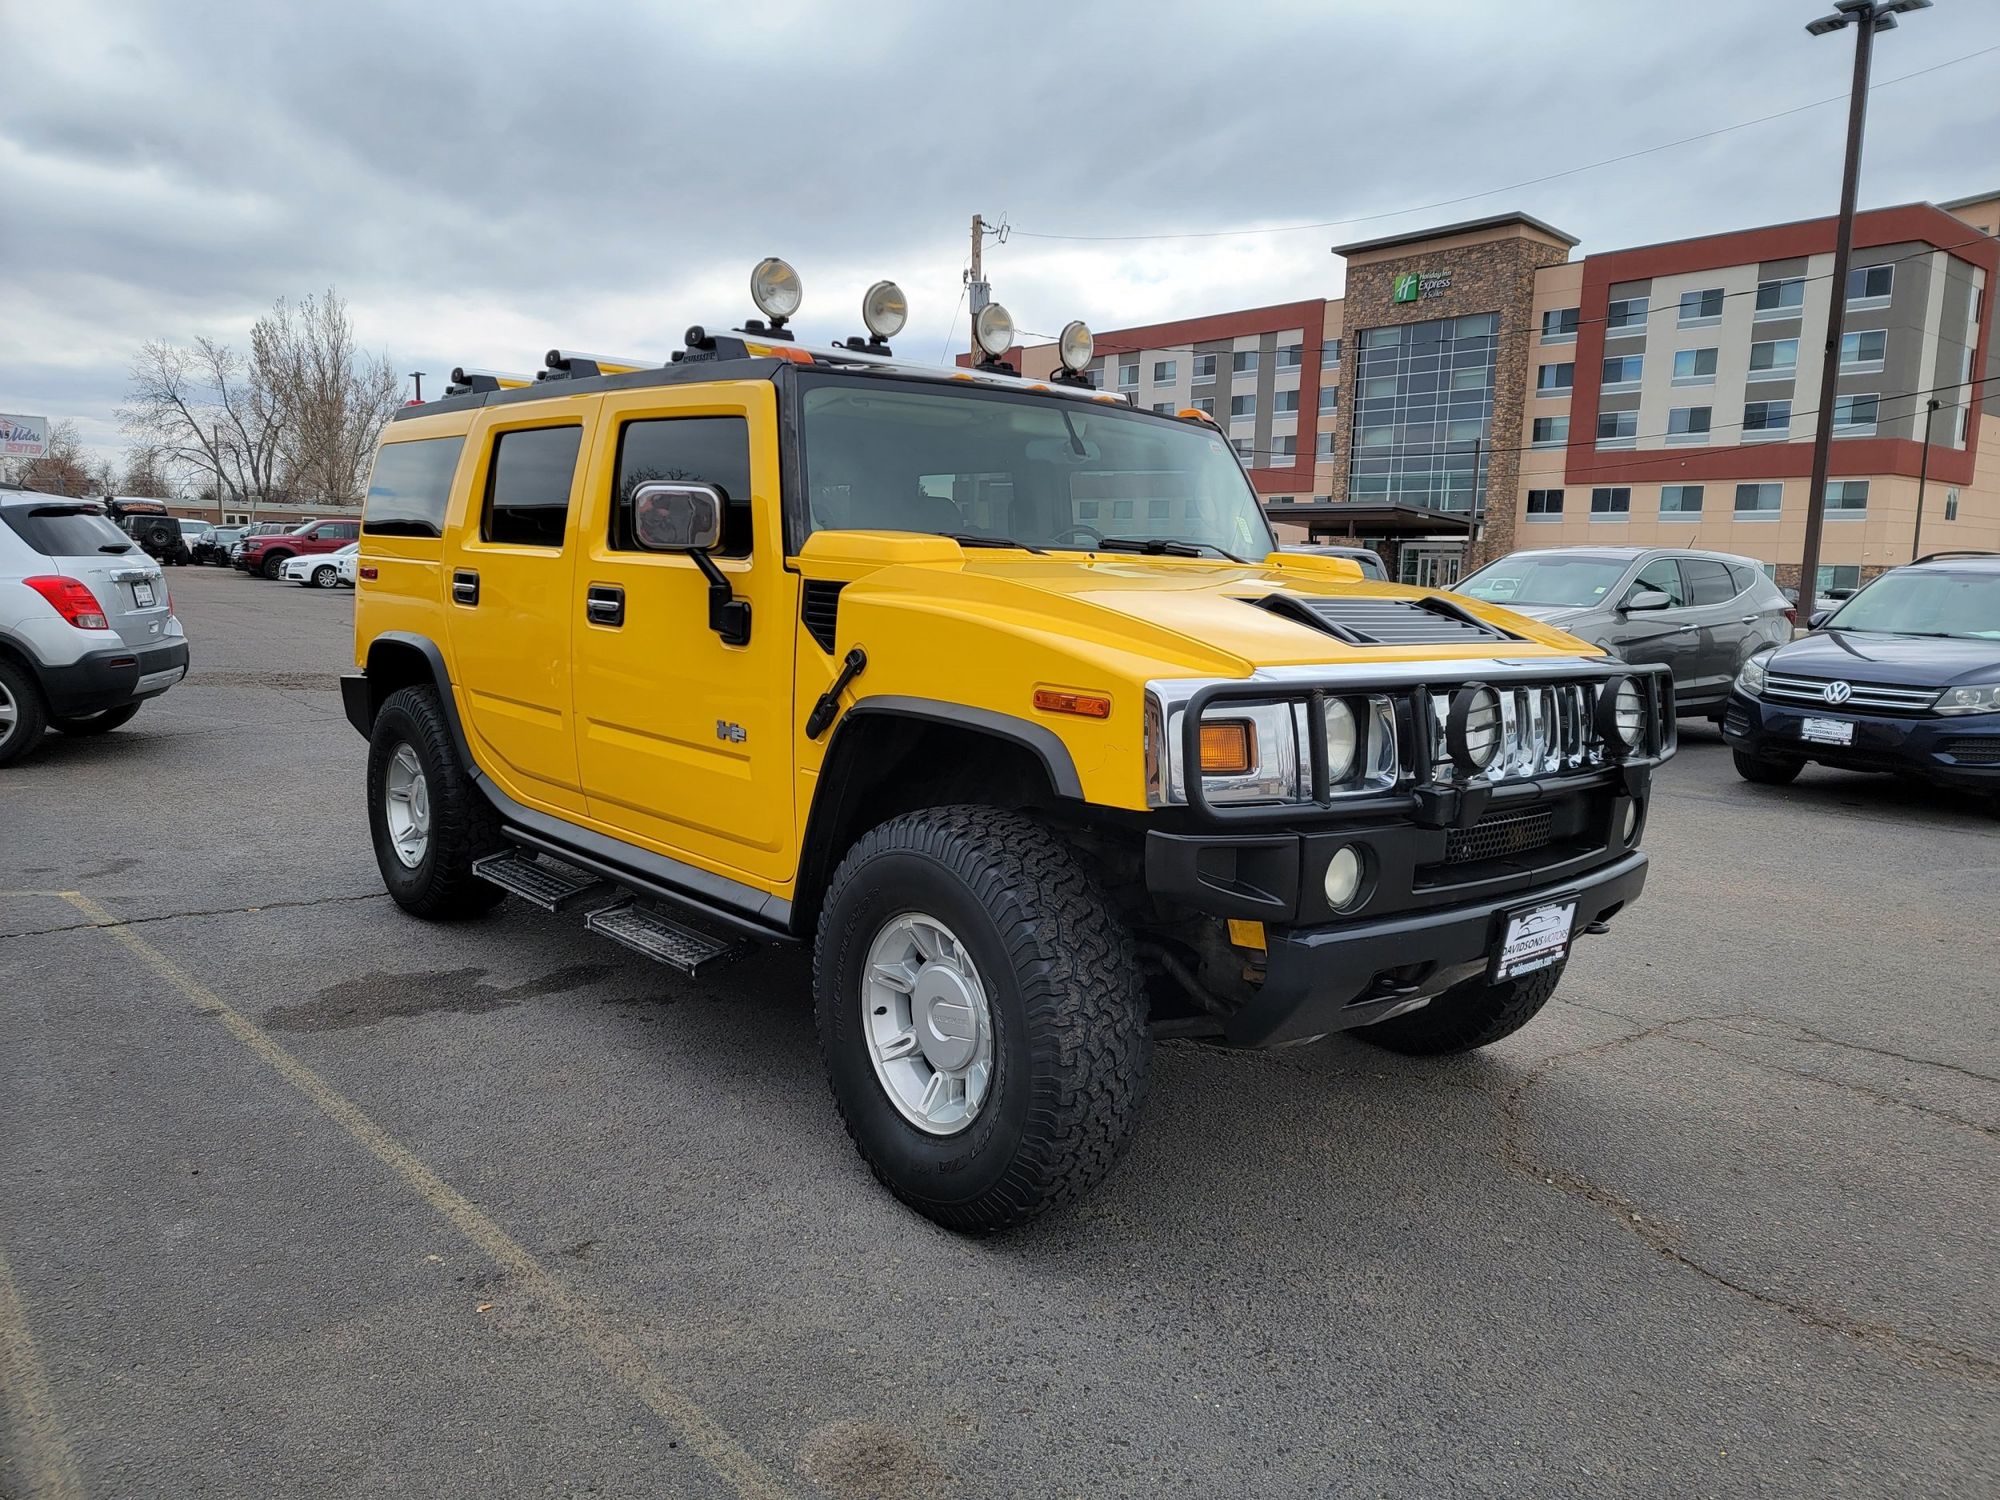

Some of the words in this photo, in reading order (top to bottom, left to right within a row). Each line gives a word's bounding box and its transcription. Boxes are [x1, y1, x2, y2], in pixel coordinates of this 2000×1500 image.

[1419, 271, 1442, 280] Holiday
[1442, 269, 1452, 277] Inn
[1418, 278, 1452, 291] Express
[7, 426, 41, 442] Motors
[716, 719, 747, 743] H2
